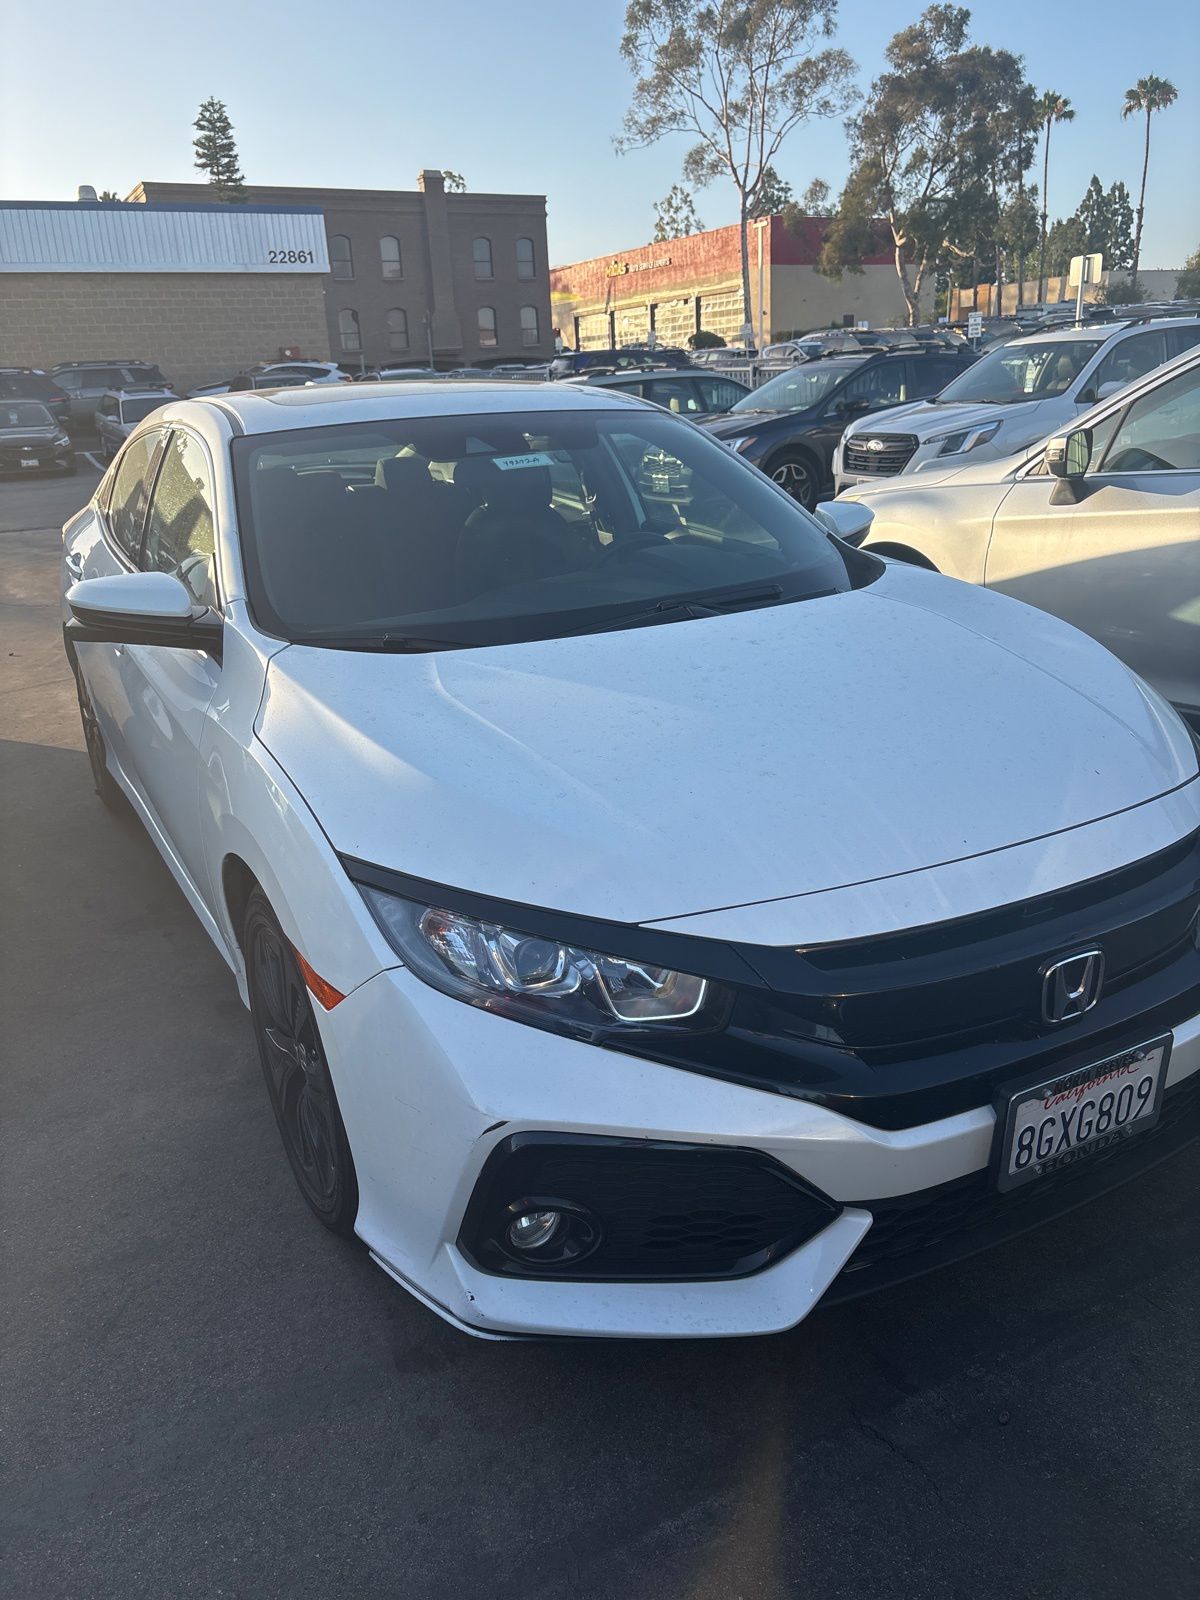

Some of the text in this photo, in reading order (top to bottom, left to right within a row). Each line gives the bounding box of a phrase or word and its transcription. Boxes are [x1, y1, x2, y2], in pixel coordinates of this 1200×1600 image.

[268, 250, 314, 264] 22861
[1014, 1075, 1153, 1169] 8GXG809
[1042, 1129, 1122, 1172] HONDA
